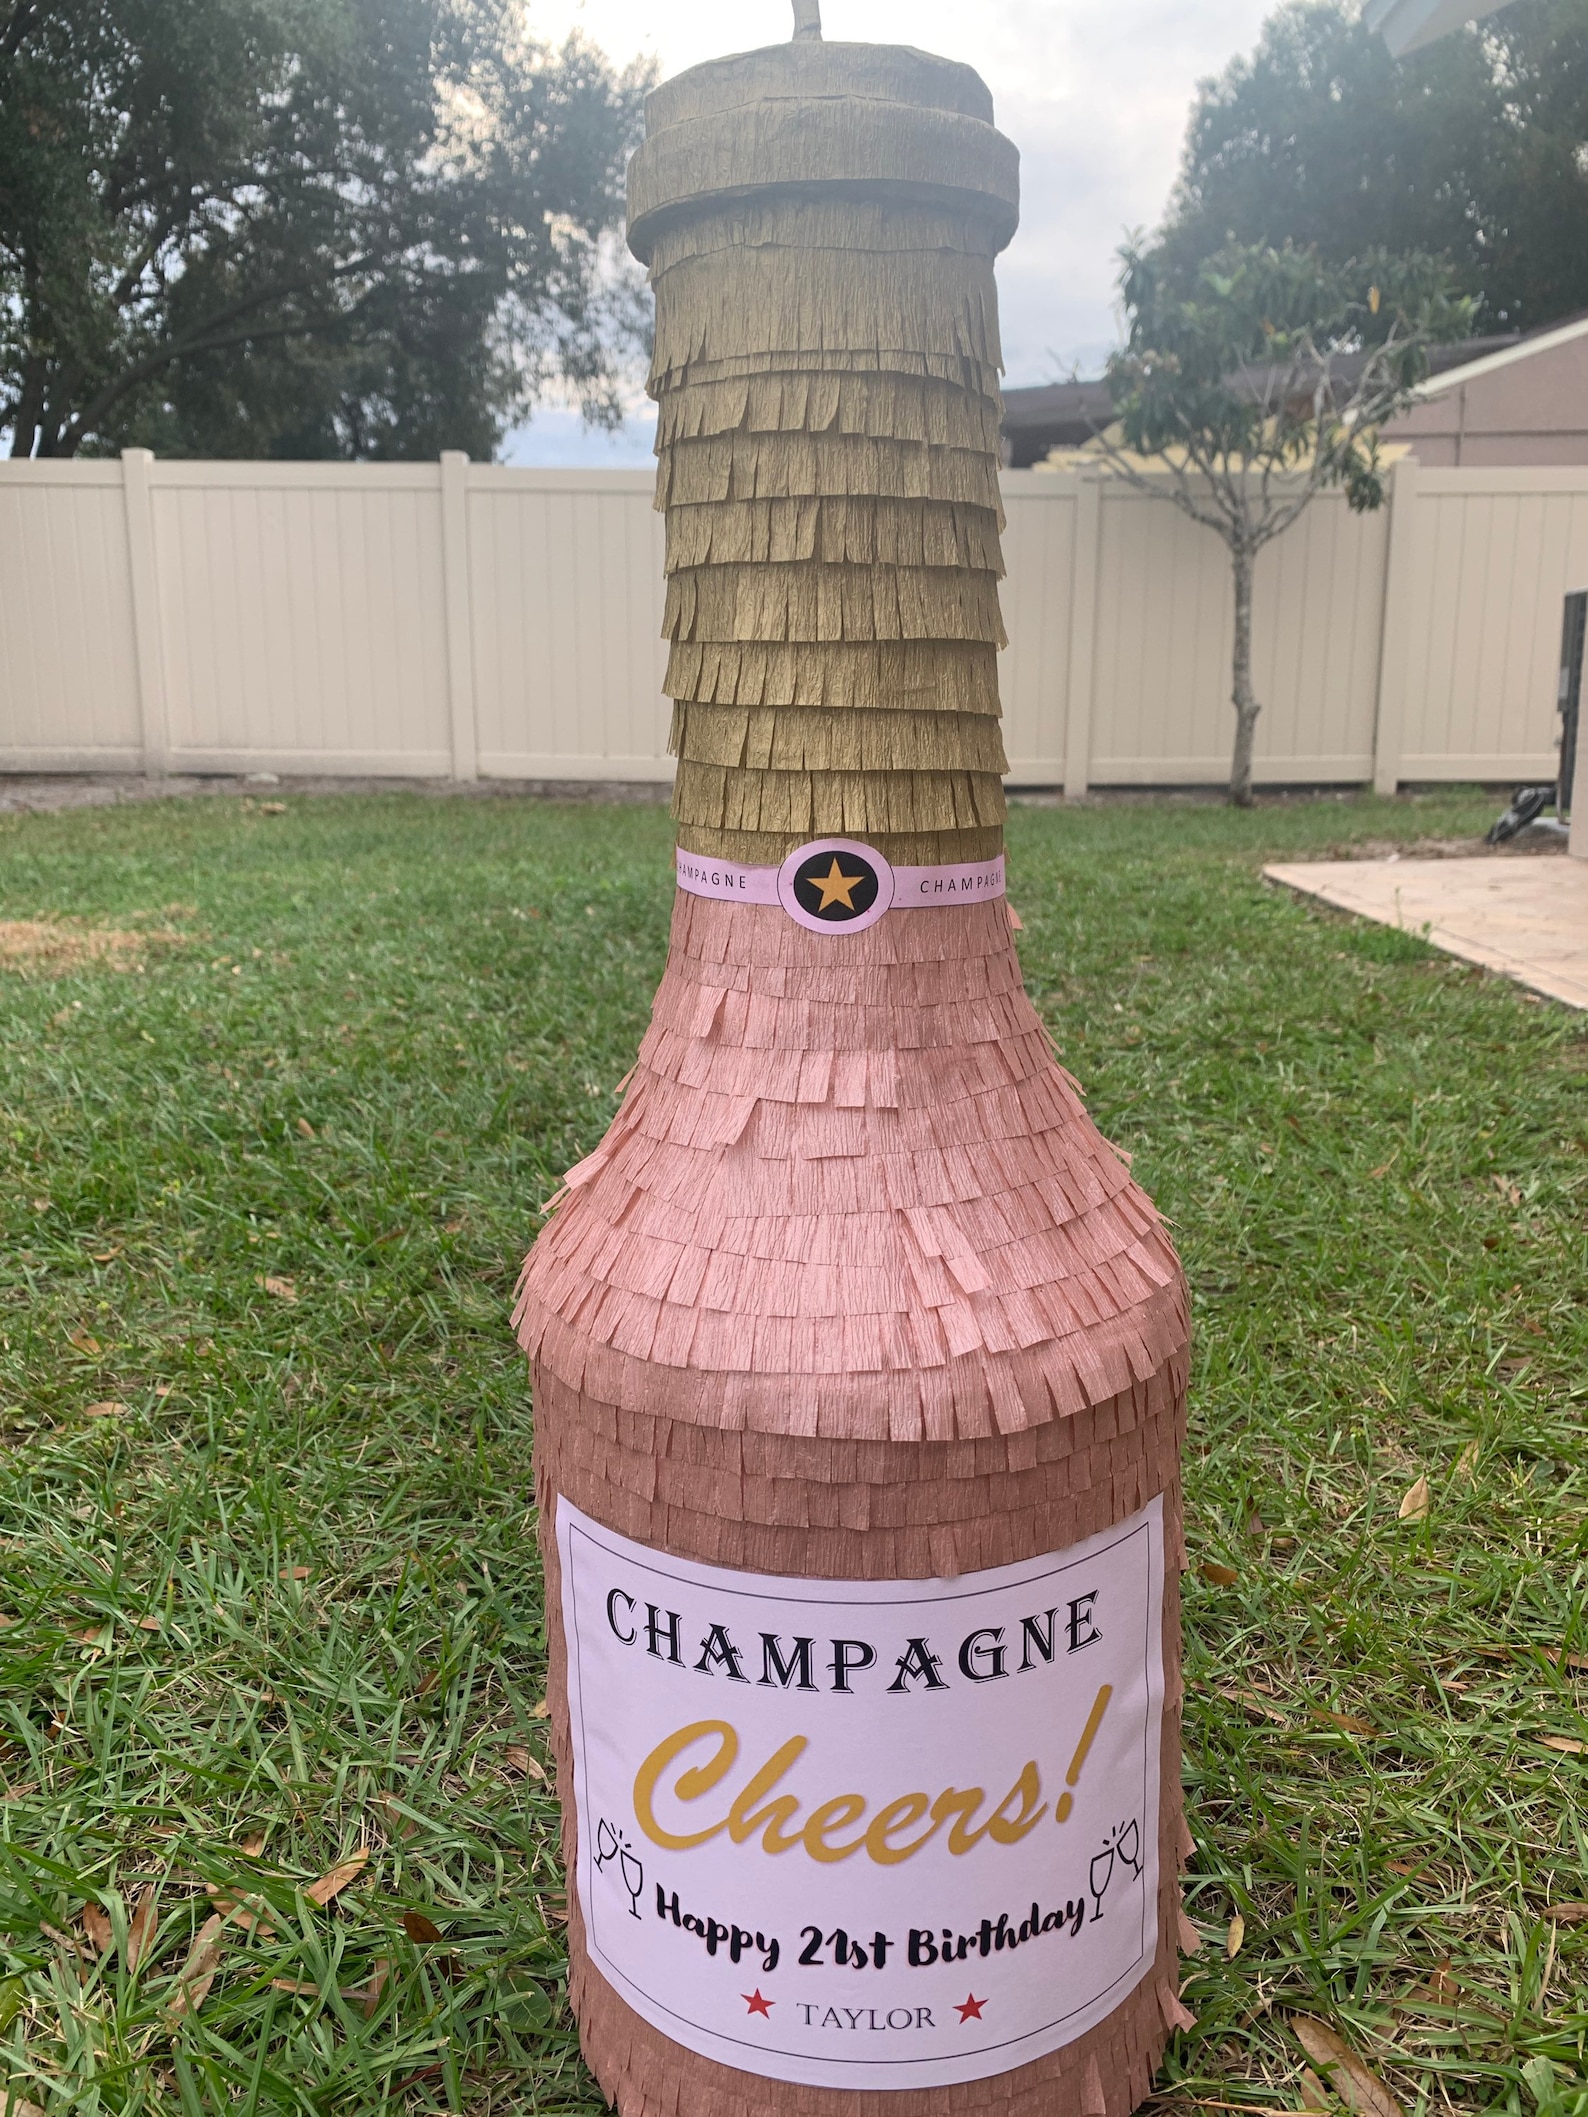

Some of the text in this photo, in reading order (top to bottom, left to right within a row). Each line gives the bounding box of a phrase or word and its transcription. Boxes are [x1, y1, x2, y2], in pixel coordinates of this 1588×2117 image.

[677, 862, 746, 889] HAMPAGNE
[606, 1588, 1103, 1693] CHAMPAGNE
[632, 1684, 1113, 1865] Cheers!
[655, 1882, 1086, 1972] Happy 21st Birthday
[796, 2002, 937, 2031] TAYLOR
